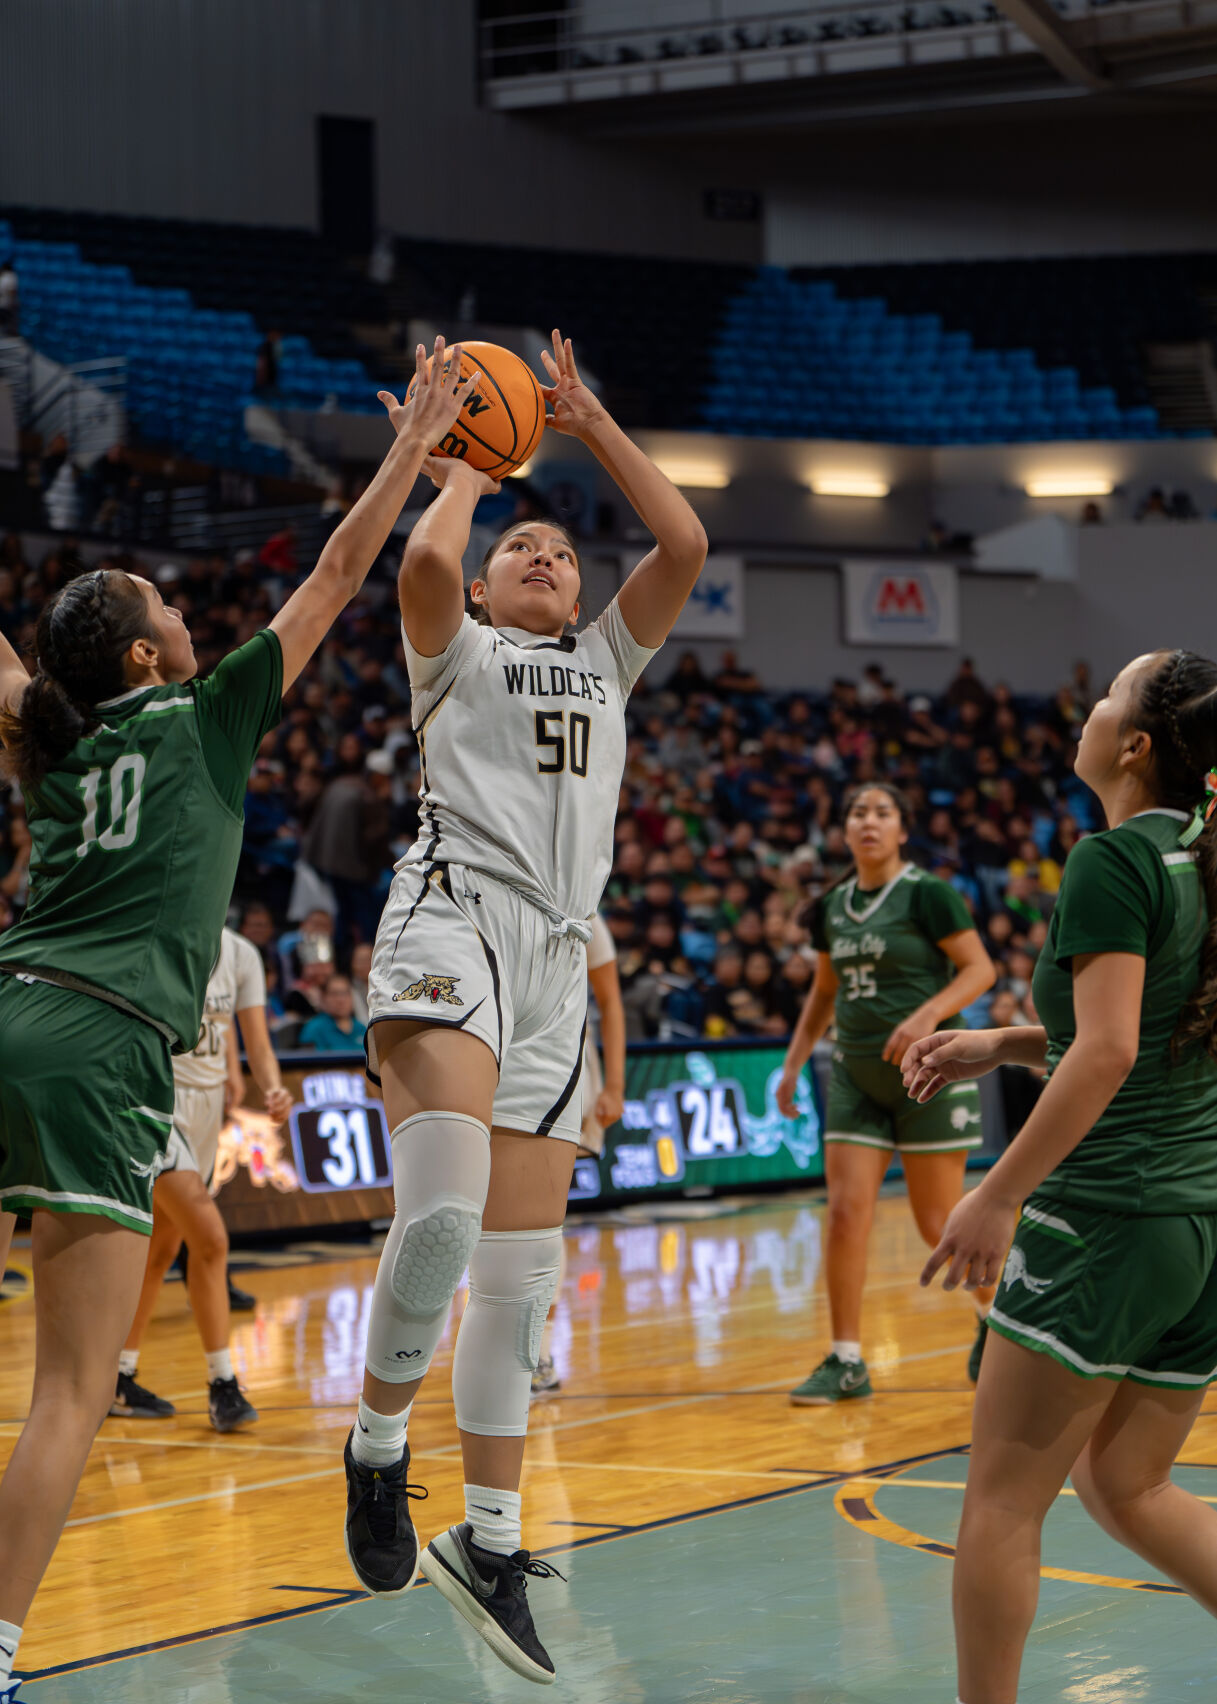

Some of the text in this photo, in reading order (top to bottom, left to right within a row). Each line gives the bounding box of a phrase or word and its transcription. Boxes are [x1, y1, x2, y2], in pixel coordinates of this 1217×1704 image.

[534, 709, 592, 779] 50
[76, 752, 146, 858] 10
[842, 963, 877, 1001] 35
[317, 1108, 377, 1187] 31
[681, 1086, 737, 1155] 24
